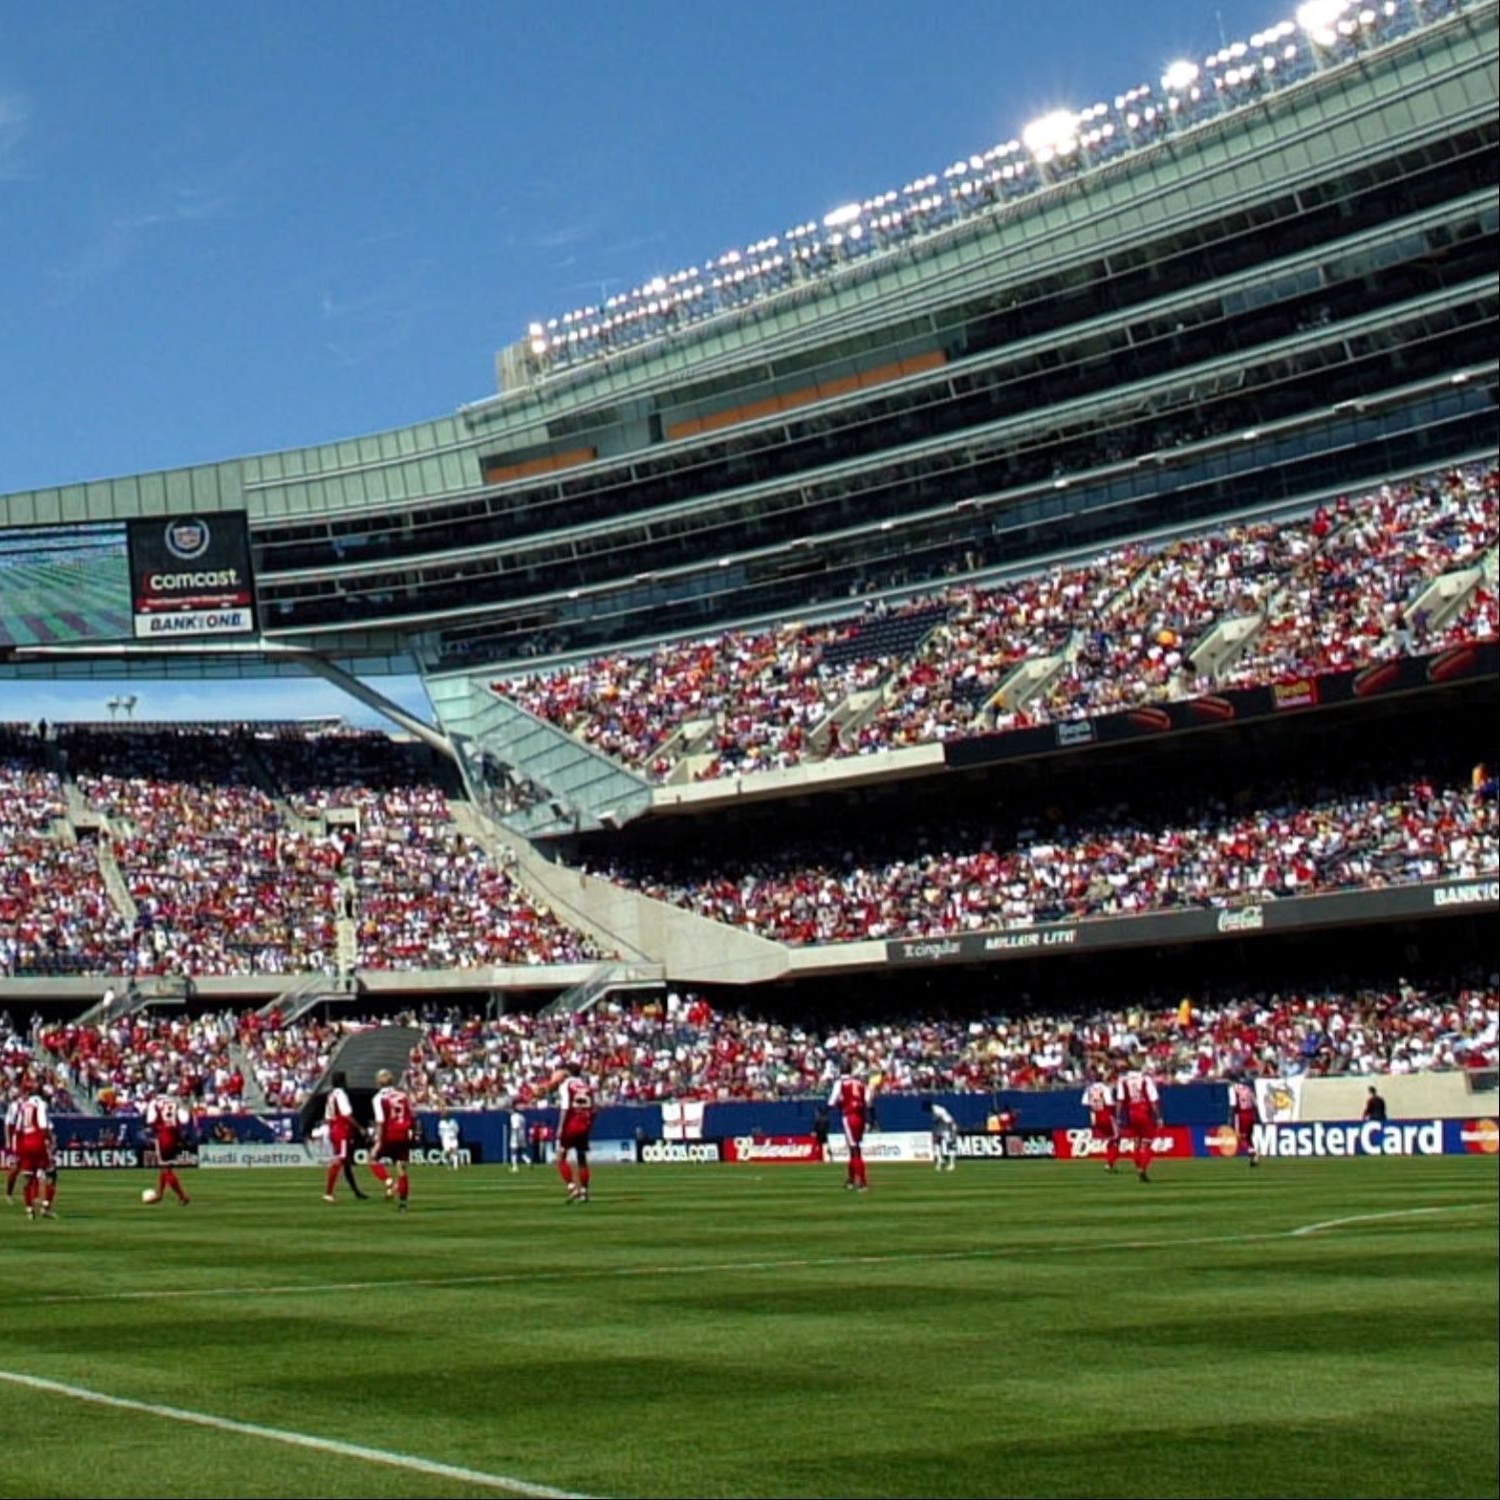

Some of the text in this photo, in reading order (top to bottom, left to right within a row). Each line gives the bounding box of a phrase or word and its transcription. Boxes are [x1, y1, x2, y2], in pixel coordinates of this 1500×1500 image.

[150, 568, 238, 590] comcast
[984, 935, 1039, 950] MILLER
[1252, 1121, 1443, 1155] MasterCard
[54, 1150, 138, 1168] SIEMENS
[202, 1151, 301, 1167] Audi quattro
